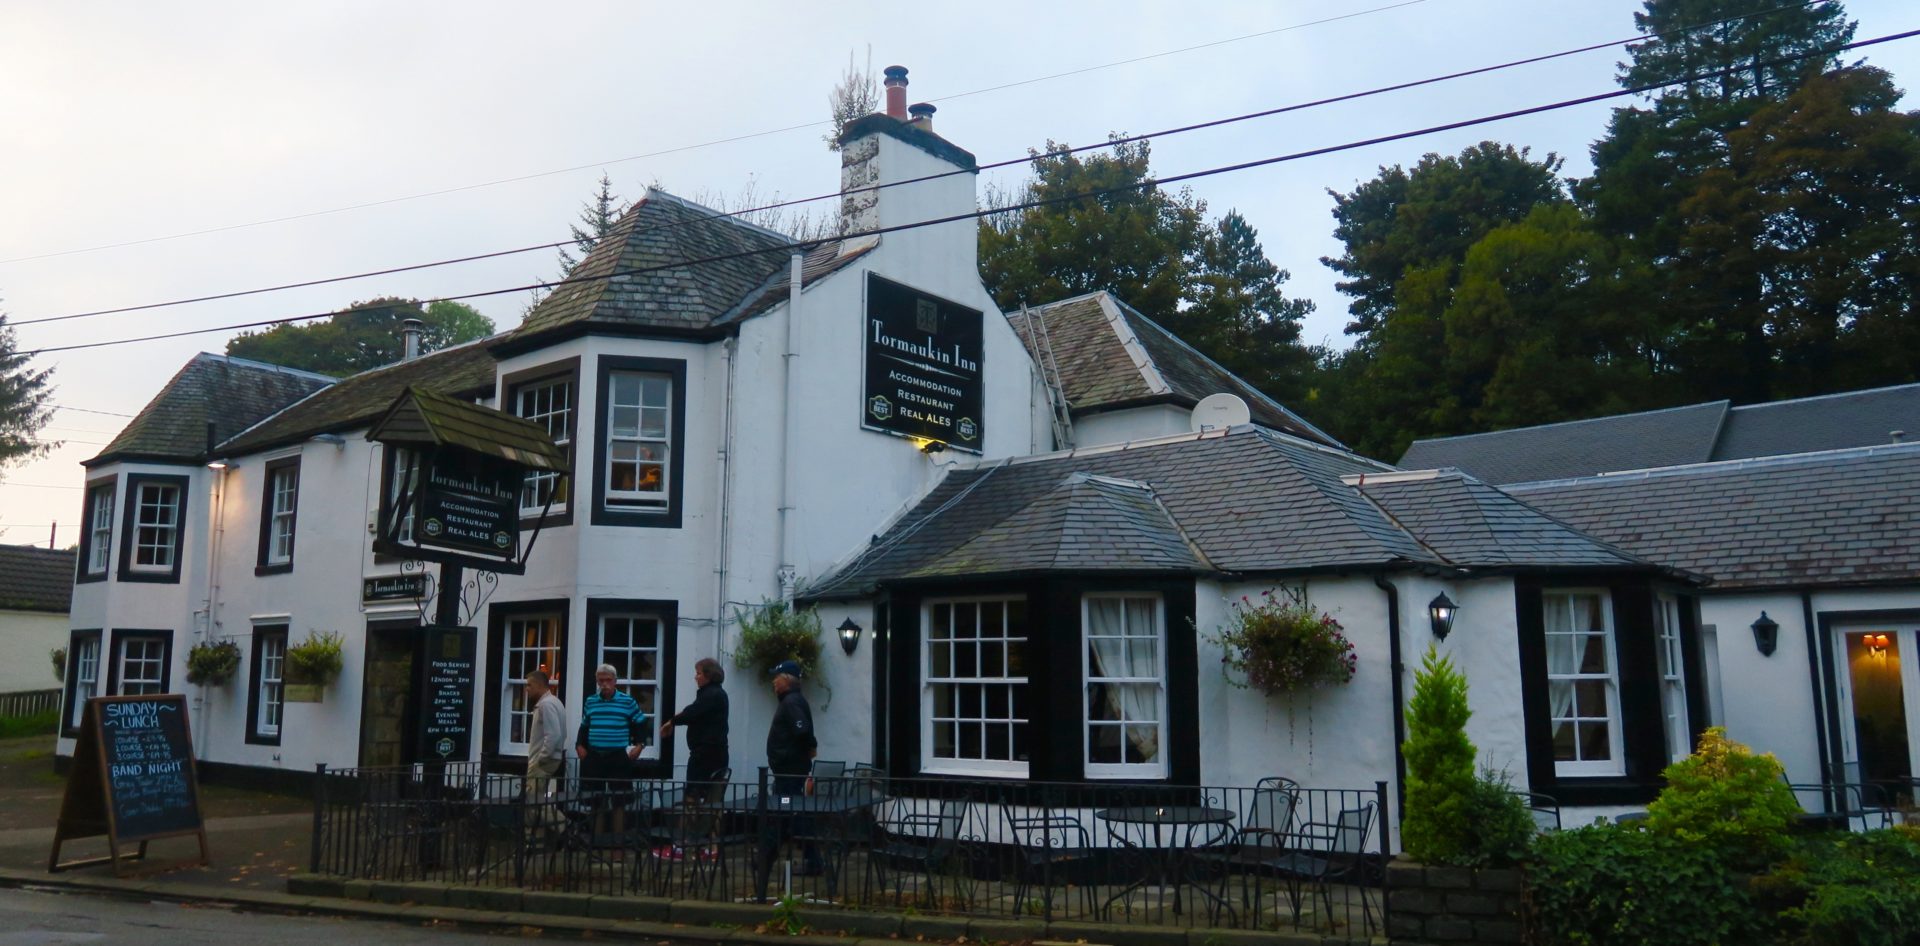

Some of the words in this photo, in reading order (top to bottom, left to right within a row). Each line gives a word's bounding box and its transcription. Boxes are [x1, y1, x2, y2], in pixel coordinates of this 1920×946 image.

[872, 319, 950, 364] Tormaukin
[954, 344, 977, 372] Inn
[888, 370, 962, 397] ACCOMMODATION
[897, 389, 954, 411] RESTAURANT
[873, 404, 889, 415] BEST
[900, 407, 924, 420] REAL
[926, 413, 951, 427] ALES
[960, 426, 974, 435] BEST
[431, 466, 491, 494] Tormaukin
[495, 480, 513, 500] Inn
[440, 501, 499, 519] ACCOMMODATION
[446, 514, 493, 529] RESTAURANT
[447, 526, 467, 536] REAL
[469, 530, 490, 540] ALES
[106, 701, 157, 717] SUNDAY
[121, 715, 160, 729] LUNCH
[112, 764, 142, 778] BAND
[148, 761, 181, 776] NIGHT
